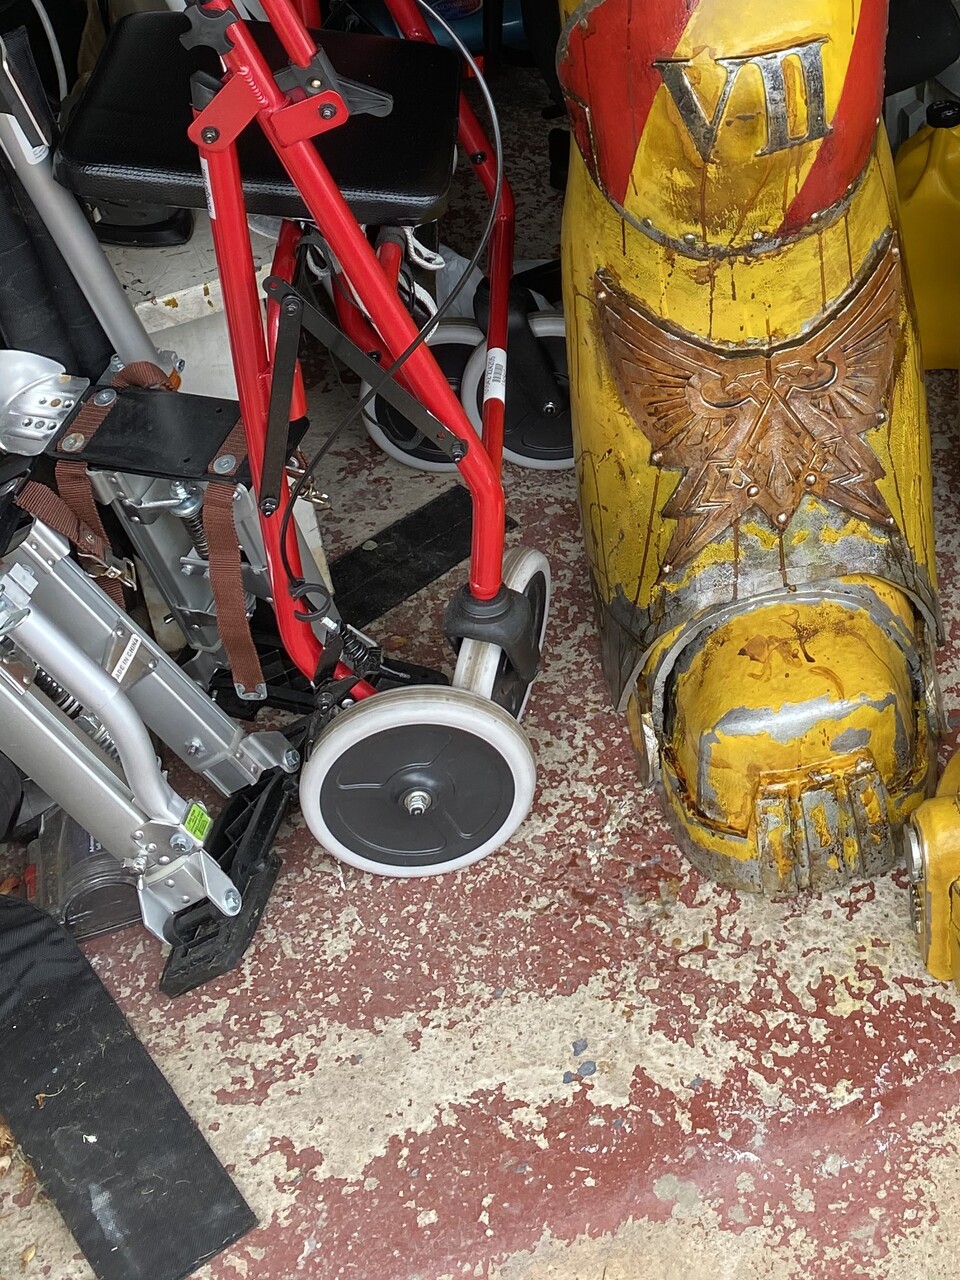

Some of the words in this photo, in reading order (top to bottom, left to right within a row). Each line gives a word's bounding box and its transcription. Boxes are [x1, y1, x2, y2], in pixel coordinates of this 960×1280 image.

[653, 37, 833, 162] VII
[115, 665, 125, 680] ADE
[122, 656, 129, 665] IN
[126, 637, 139, 657] CHINA
